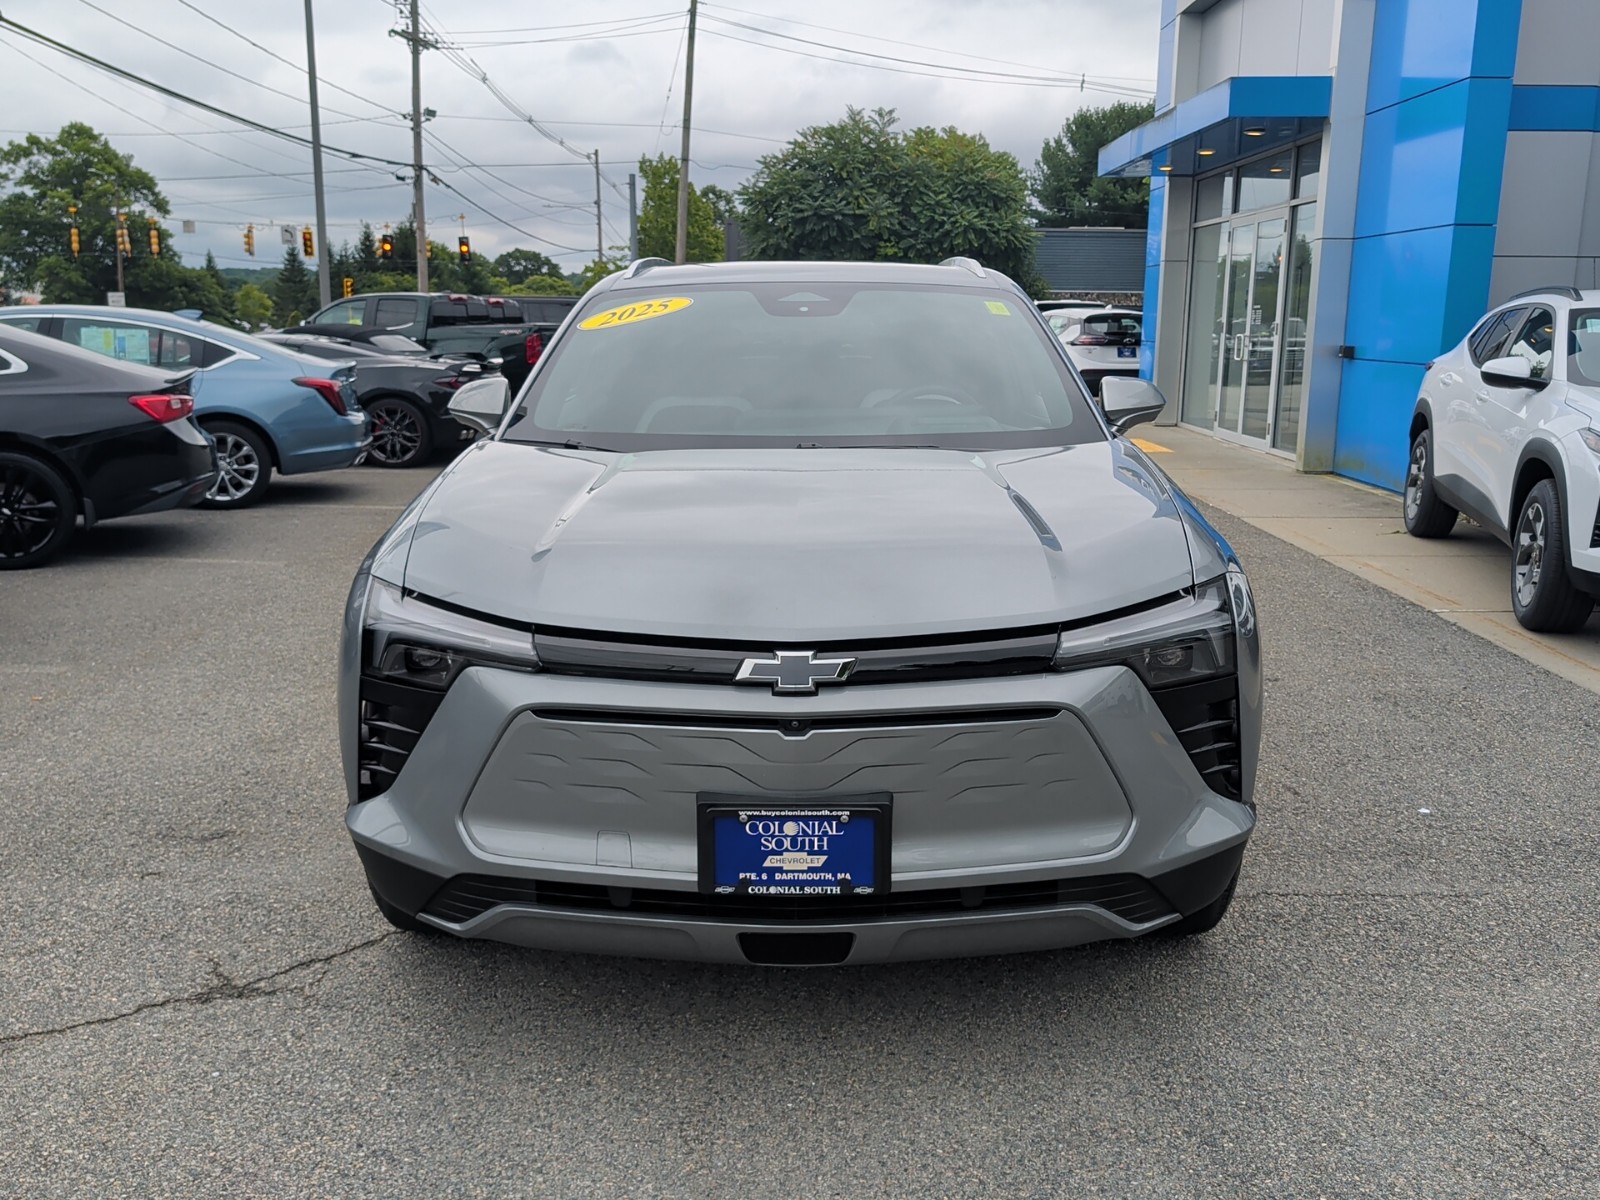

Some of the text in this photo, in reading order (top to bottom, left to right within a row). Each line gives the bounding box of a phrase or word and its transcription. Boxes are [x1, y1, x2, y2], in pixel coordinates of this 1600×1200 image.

[597, 299, 673, 327] 2025
[745, 820, 844, 836] COLONIAL
[760, 836, 829, 851] SOUTH
[769, 857, 821, 865] CHEVROLET
[761, 872, 768, 880] 6
[774, 872, 835, 882] DARTMOUTH,
[837, 872, 852, 880] MA
[748, 885, 841, 895] COLONIAL SOUTH
